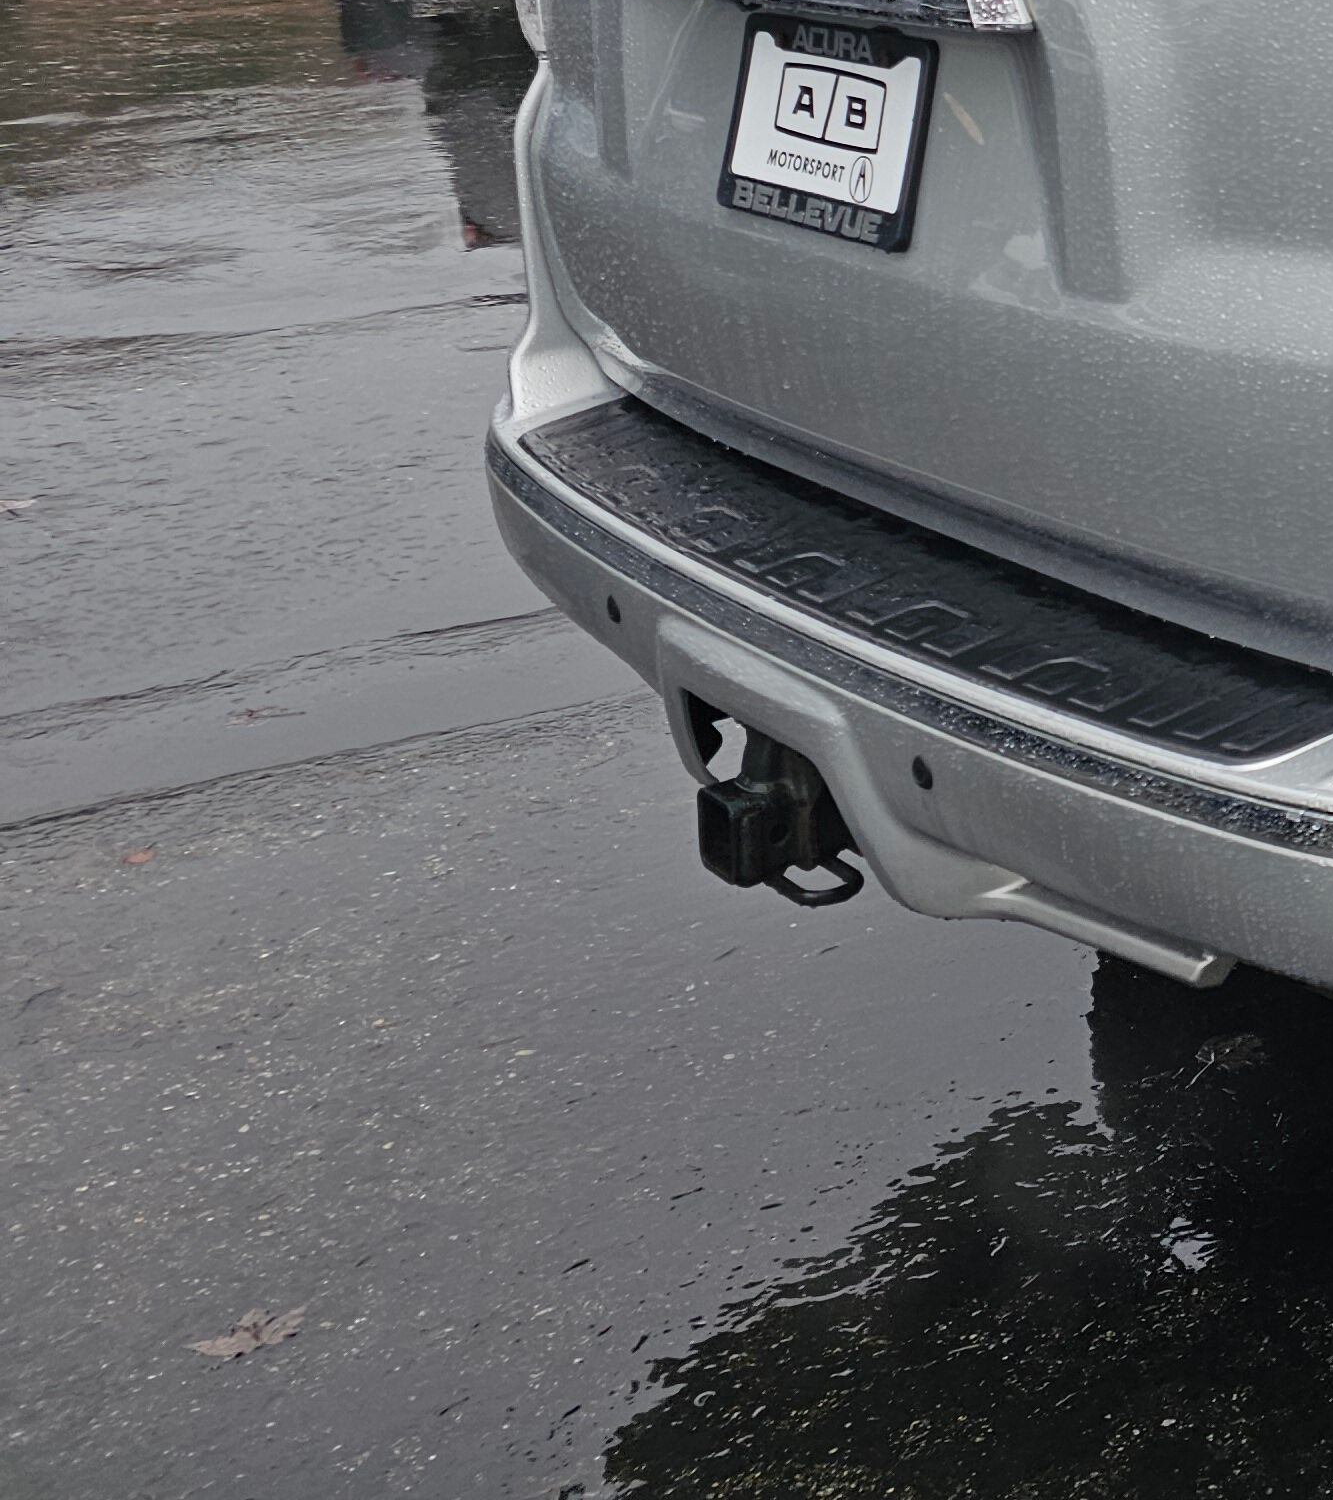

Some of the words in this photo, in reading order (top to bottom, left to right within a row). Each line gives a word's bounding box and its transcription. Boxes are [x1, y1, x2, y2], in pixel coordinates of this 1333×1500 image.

[791, 24, 875, 64] ACURA
[791, 84, 815, 120] A
[844, 94, 867, 131] B
[766, 148, 846, 184] MOTORSPORT
[731, 178, 884, 245] BELLEVUE
